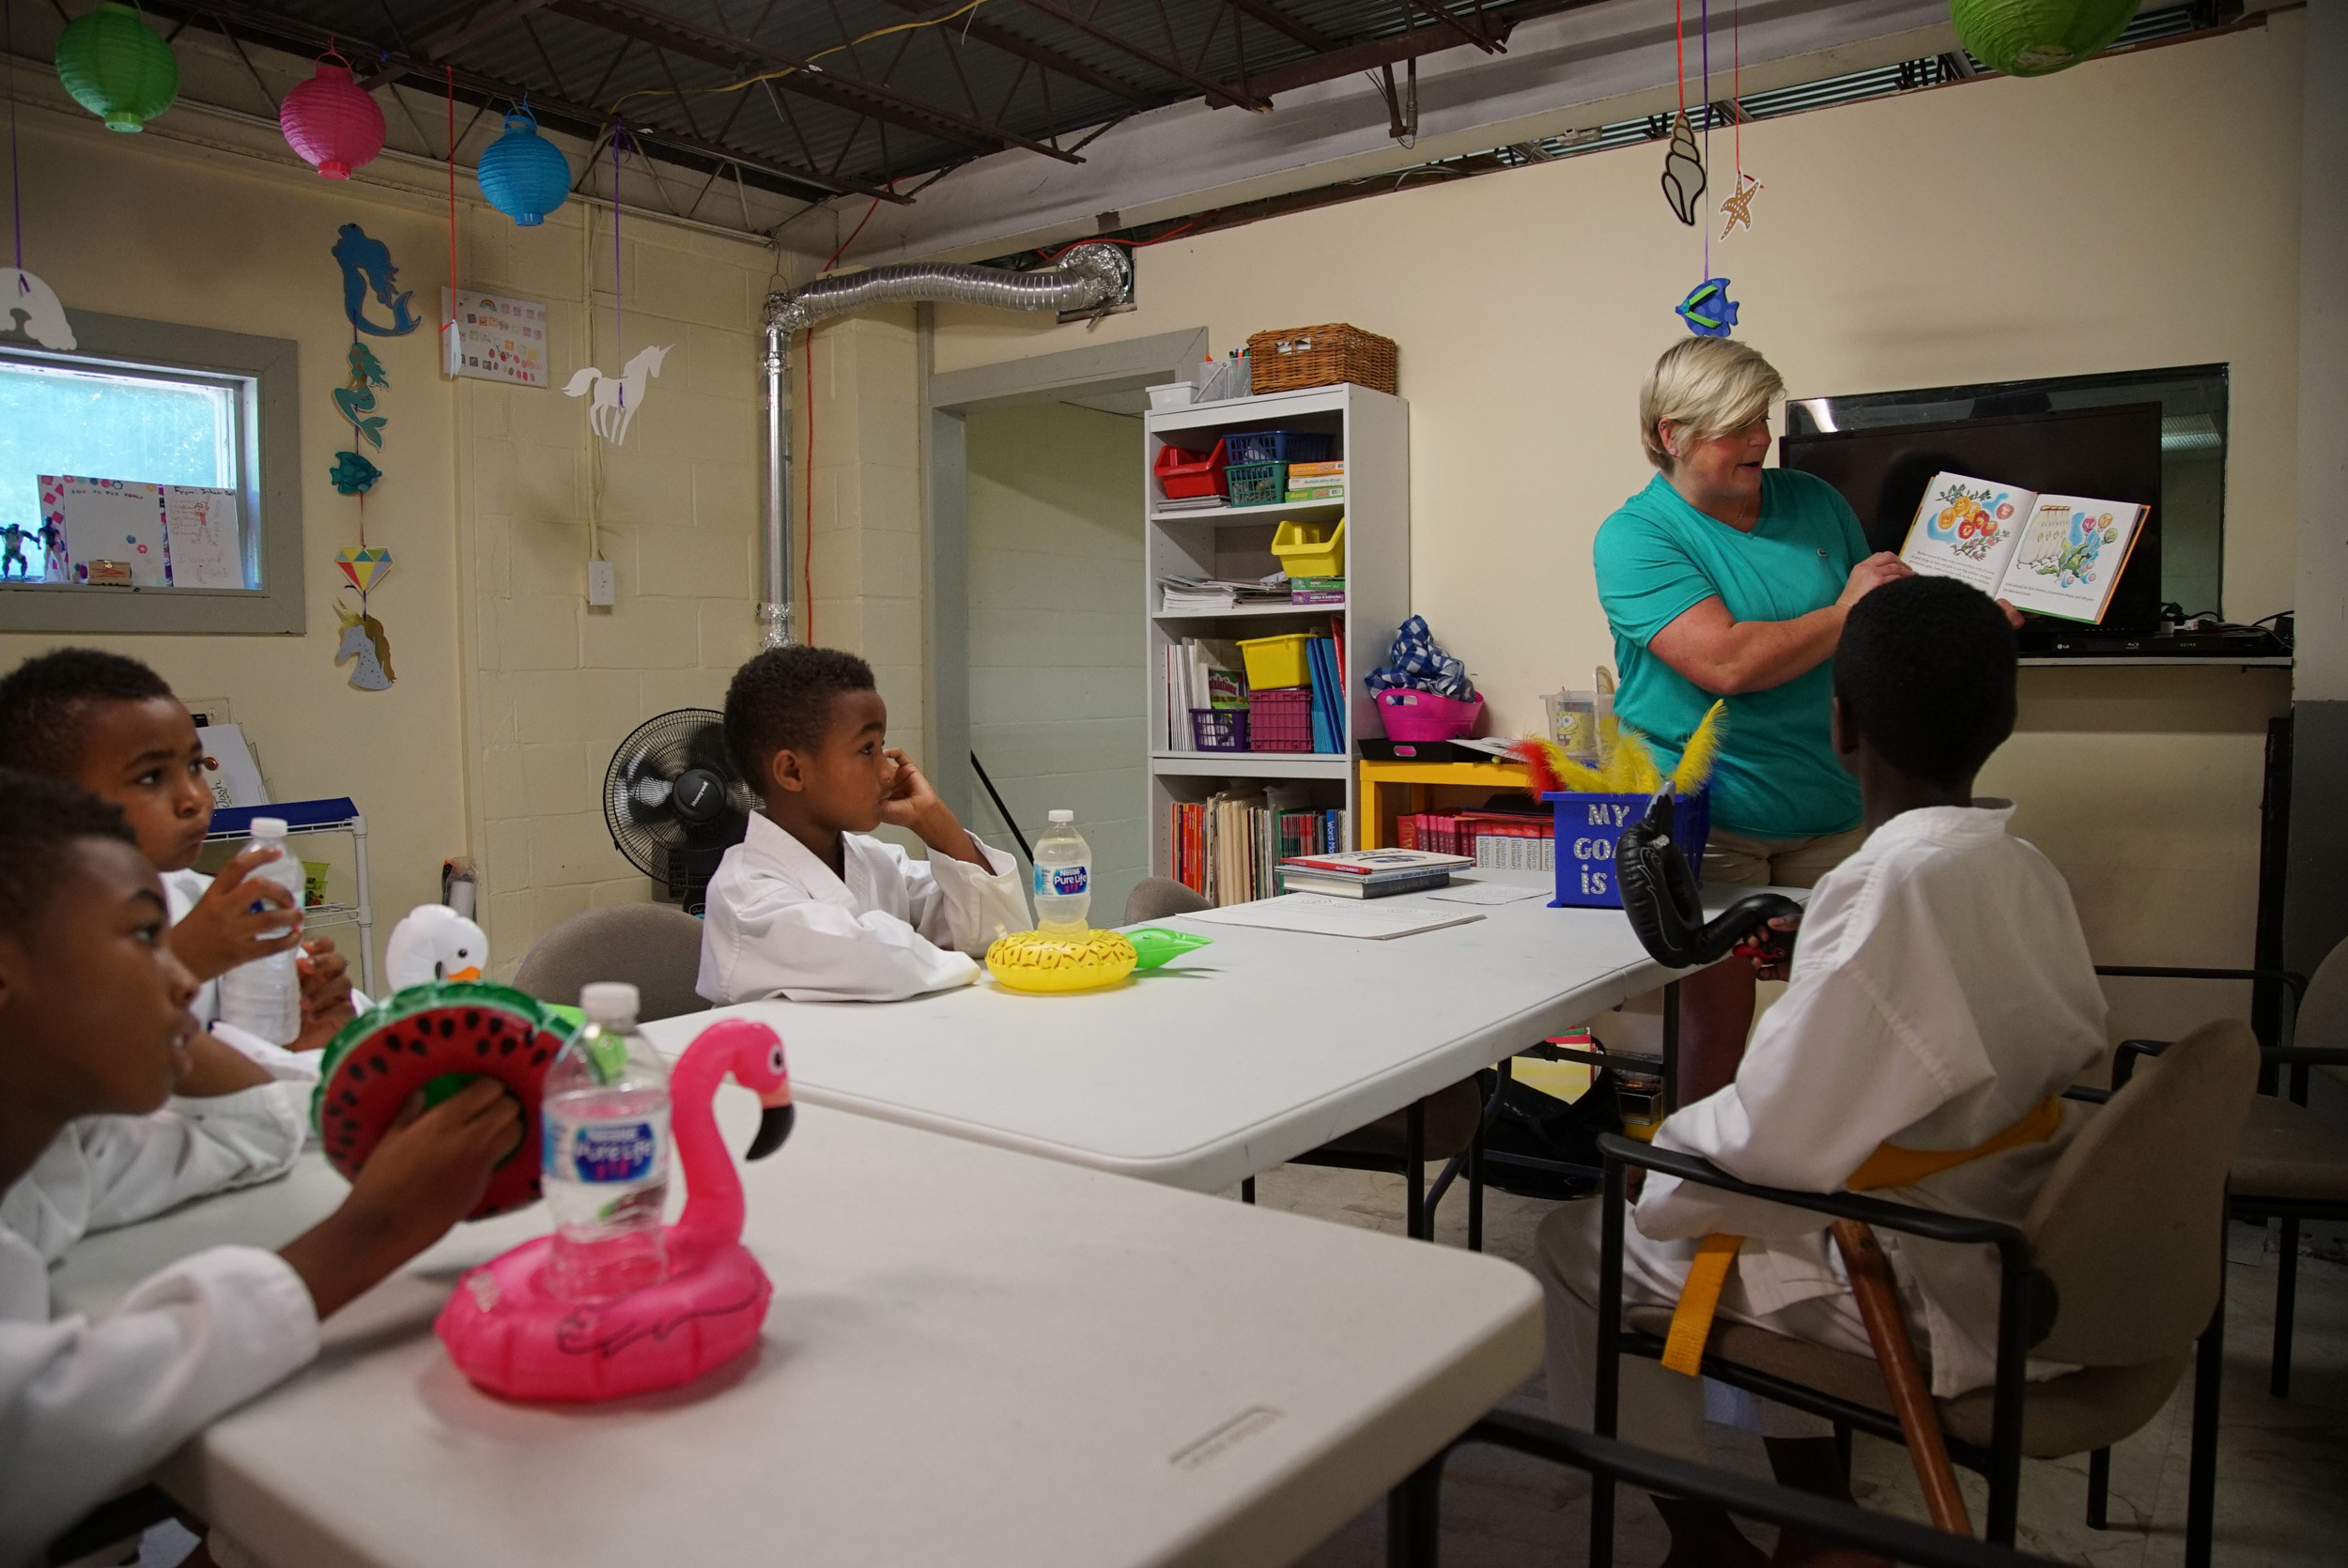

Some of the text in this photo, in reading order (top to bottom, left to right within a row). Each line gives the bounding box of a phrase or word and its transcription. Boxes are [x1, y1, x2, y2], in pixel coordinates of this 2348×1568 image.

[690, 780, 709, 807] Honeywell
[1588, 803, 1630, 827] MY
[1573, 837, 1619, 861] GO
[1054, 875, 1074, 885] Pure
[1074, 873, 1087, 886] Life
